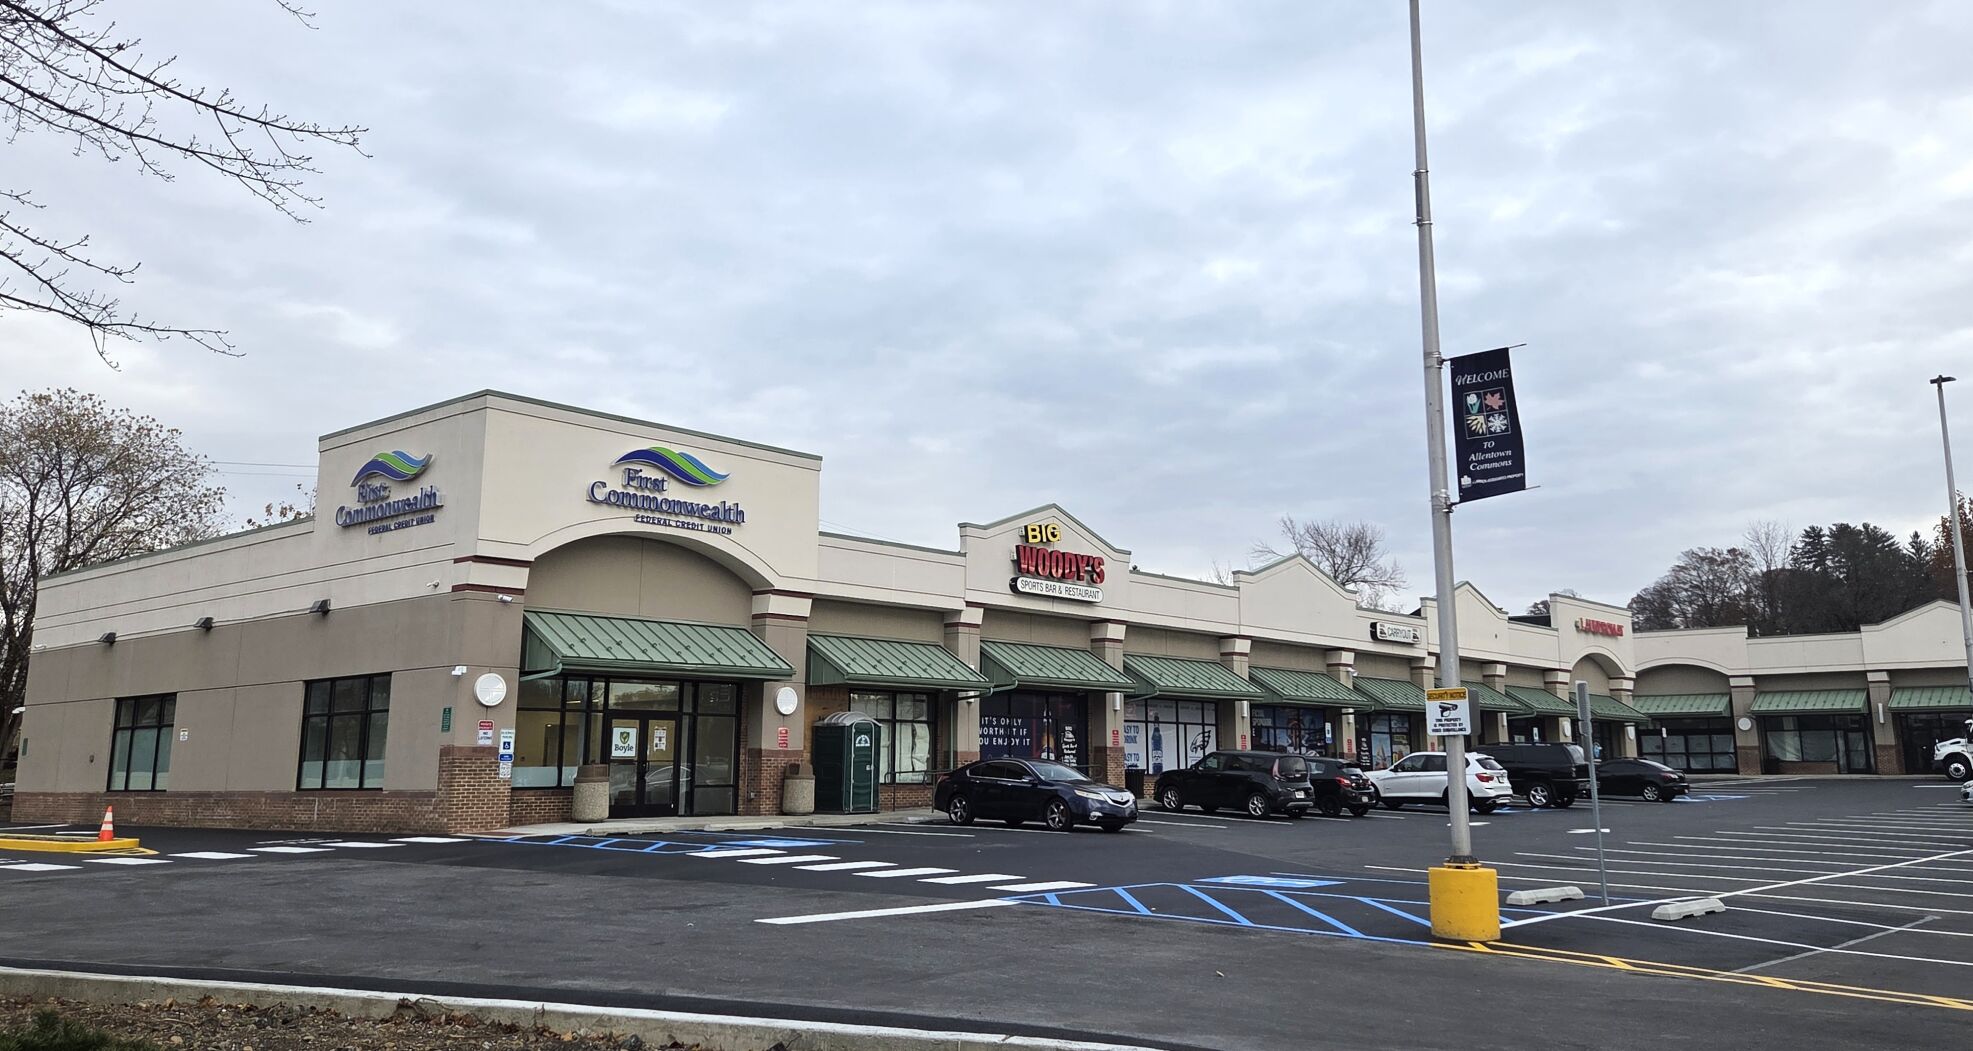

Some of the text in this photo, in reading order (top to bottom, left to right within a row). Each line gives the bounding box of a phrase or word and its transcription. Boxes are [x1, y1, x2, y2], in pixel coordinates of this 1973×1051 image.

[1455, 368, 1510, 386] WELCOME
[1483, 441, 1495, 449] TO
[1469, 450, 1512, 461] Allentown
[1469, 460, 1513, 471] Commons
[623, 467, 668, 492] First
[358, 482, 390, 503] First
[335, 485, 438, 527] Commonwealth
[588, 481, 746, 525] Commonwealth
[367, 514, 436, 535] FEDERAL CREDIT UNION
[634, 514, 733, 535] FEDERAL CREDIT UNION
[1025, 523, 1062, 543] BIG
[1016, 545, 1106, 585] WOODY'S
[1020, 579, 1100, 600] SPORTS BAR & RESTAURANT
[981, 717, 997, 726] IT'S
[1123, 725, 1140, 735] ASY TO
[1019, 728, 1028, 736] IF
[614, 744, 634, 753] Boyle
[979, 737, 989, 745] OU
[1023, 738, 1031, 746] IT
[1133, 753, 1140, 762] TO
